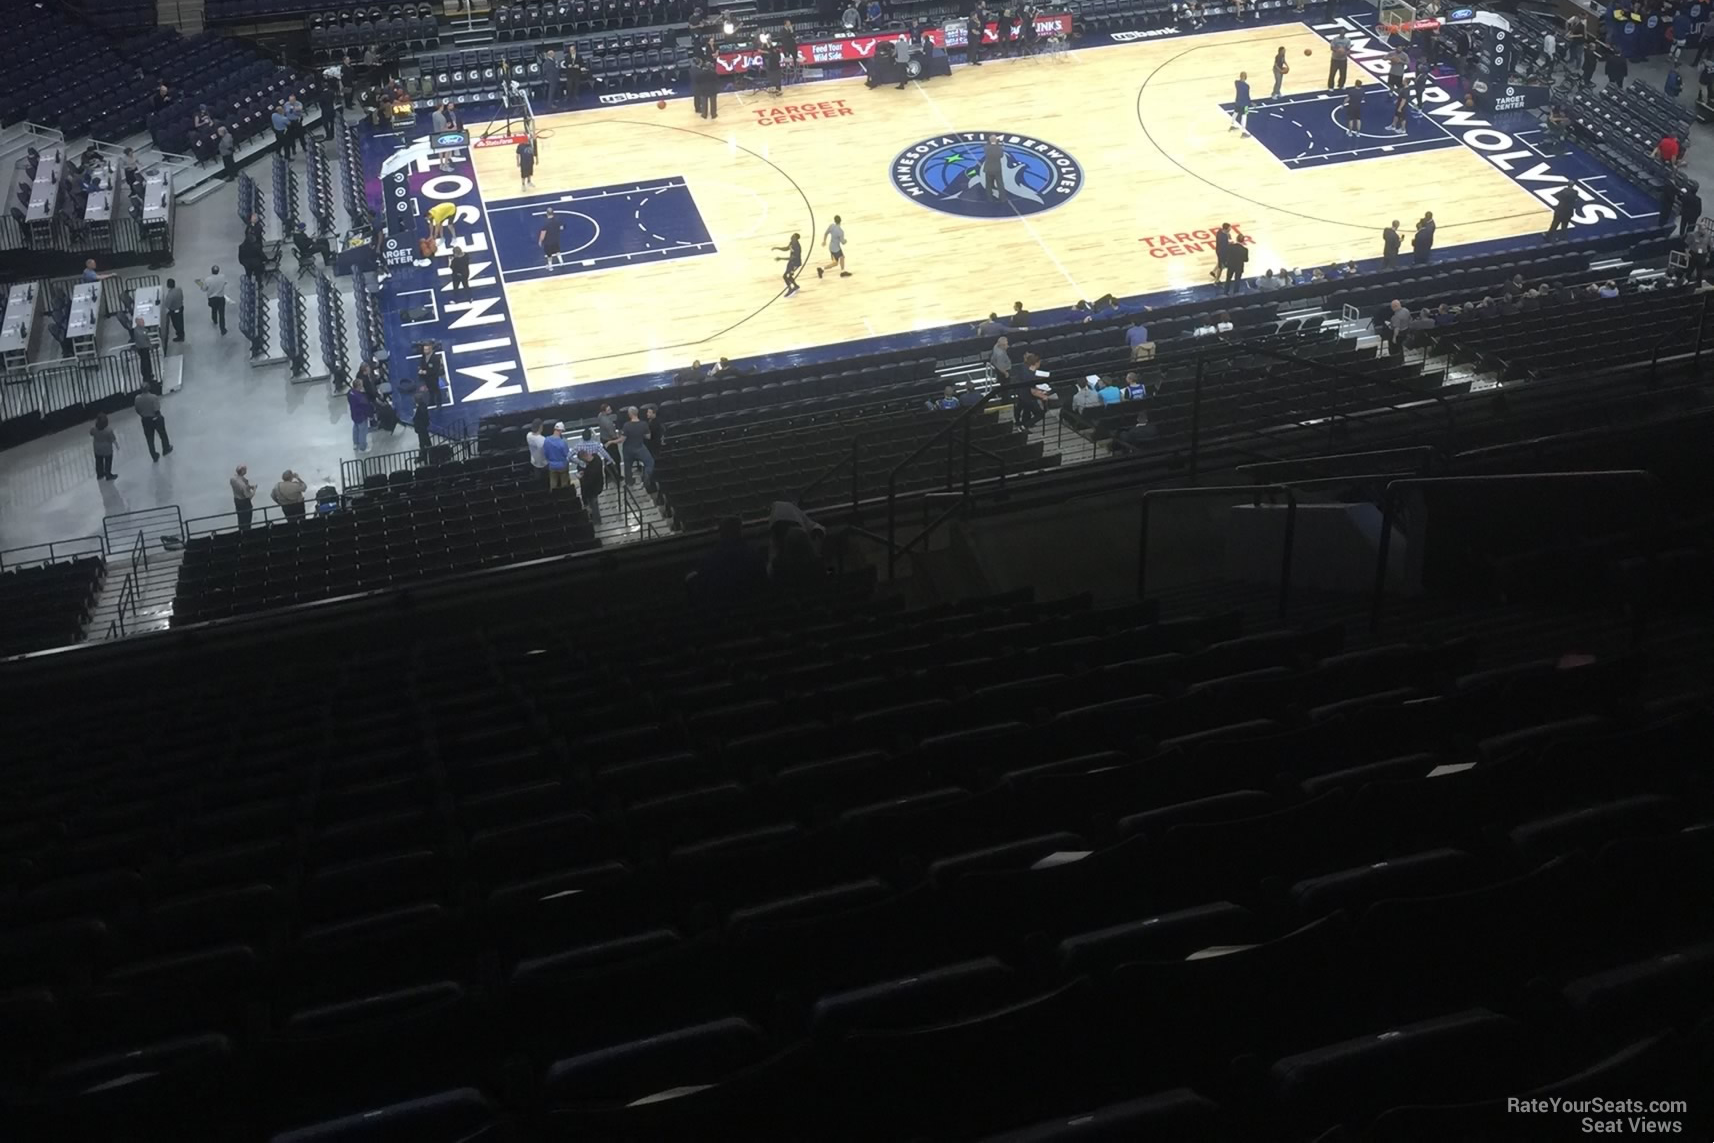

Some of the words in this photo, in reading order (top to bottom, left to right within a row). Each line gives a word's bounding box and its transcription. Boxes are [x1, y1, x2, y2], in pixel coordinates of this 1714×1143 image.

[812, 45, 827, 53] Feed
[828, 43, 843, 52] Your
[813, 53, 829, 62] Wild
[485, 68, 493, 78] G
[515, 65, 523, 74] G
[530, 63, 538, 73] G
[439, 73, 447, 82] G
[454, 71, 462, 81] G
[470, 70, 478, 79] G
[1496, 95, 1525, 105] TARGET
[753, 99, 847, 118] TARGET
[1495, 102, 1524, 111] CENTER
[758, 108, 854, 126] CENTER
[440, 136, 462, 144] Ford
[898, 135, 955, 196] MINNESOTA
[1149, 235, 1256, 258] CENTR
[387, 255, 414, 265] NTER
[413, 135, 522, 403] MINNESOT
